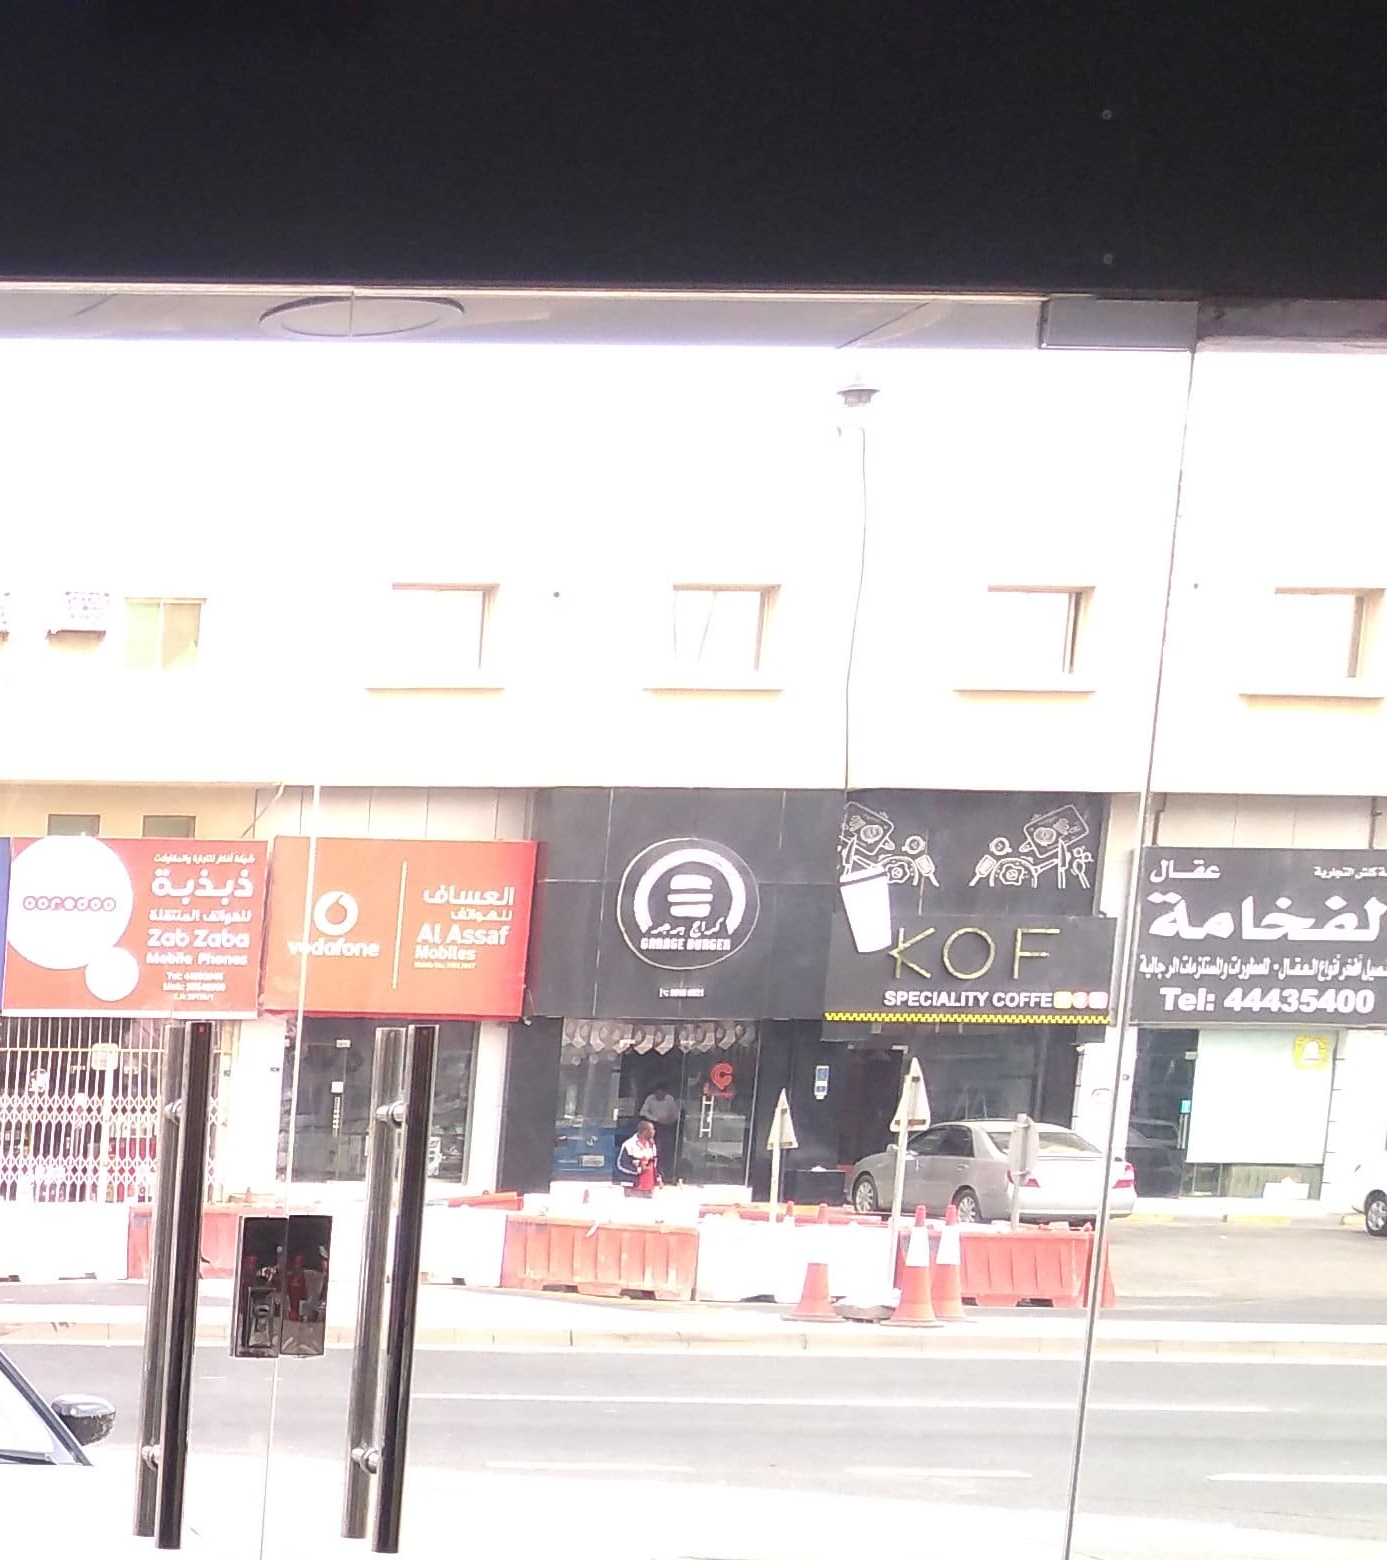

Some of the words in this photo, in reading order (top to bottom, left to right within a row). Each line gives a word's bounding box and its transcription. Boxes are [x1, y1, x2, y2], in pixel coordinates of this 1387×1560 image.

[1149, 858, 1221, 883] عقال
[150, 868, 254, 906] ذبذبة
[423, 885, 516, 906] العساف
[23, 895, 116, 912] ooredoo
[1147, 891, 1387, 942] لفخامة
[147, 928, 190, 948] Zab
[193, 928, 251, 948] Zaba
[417, 923, 442, 945] Al
[446, 924, 511, 946] Assaf
[640, 937, 685, 951] GARAGE
[686, 938, 731, 951] BURGER
[287, 937, 380, 957] vodafone
[414, 943, 477, 961] Mobiles
[888, 927, 1060, 980] KOF
[145, 951, 193, 966] Mobile
[197, 952, 249, 966] Phones
[883, 990, 990, 1008] SPECIALITY
[992, 991, 1053, 1009] COFFE
[1159, 986, 1216, 1012] Tel:
[1223, 987, 1375, 1014] 44435400
